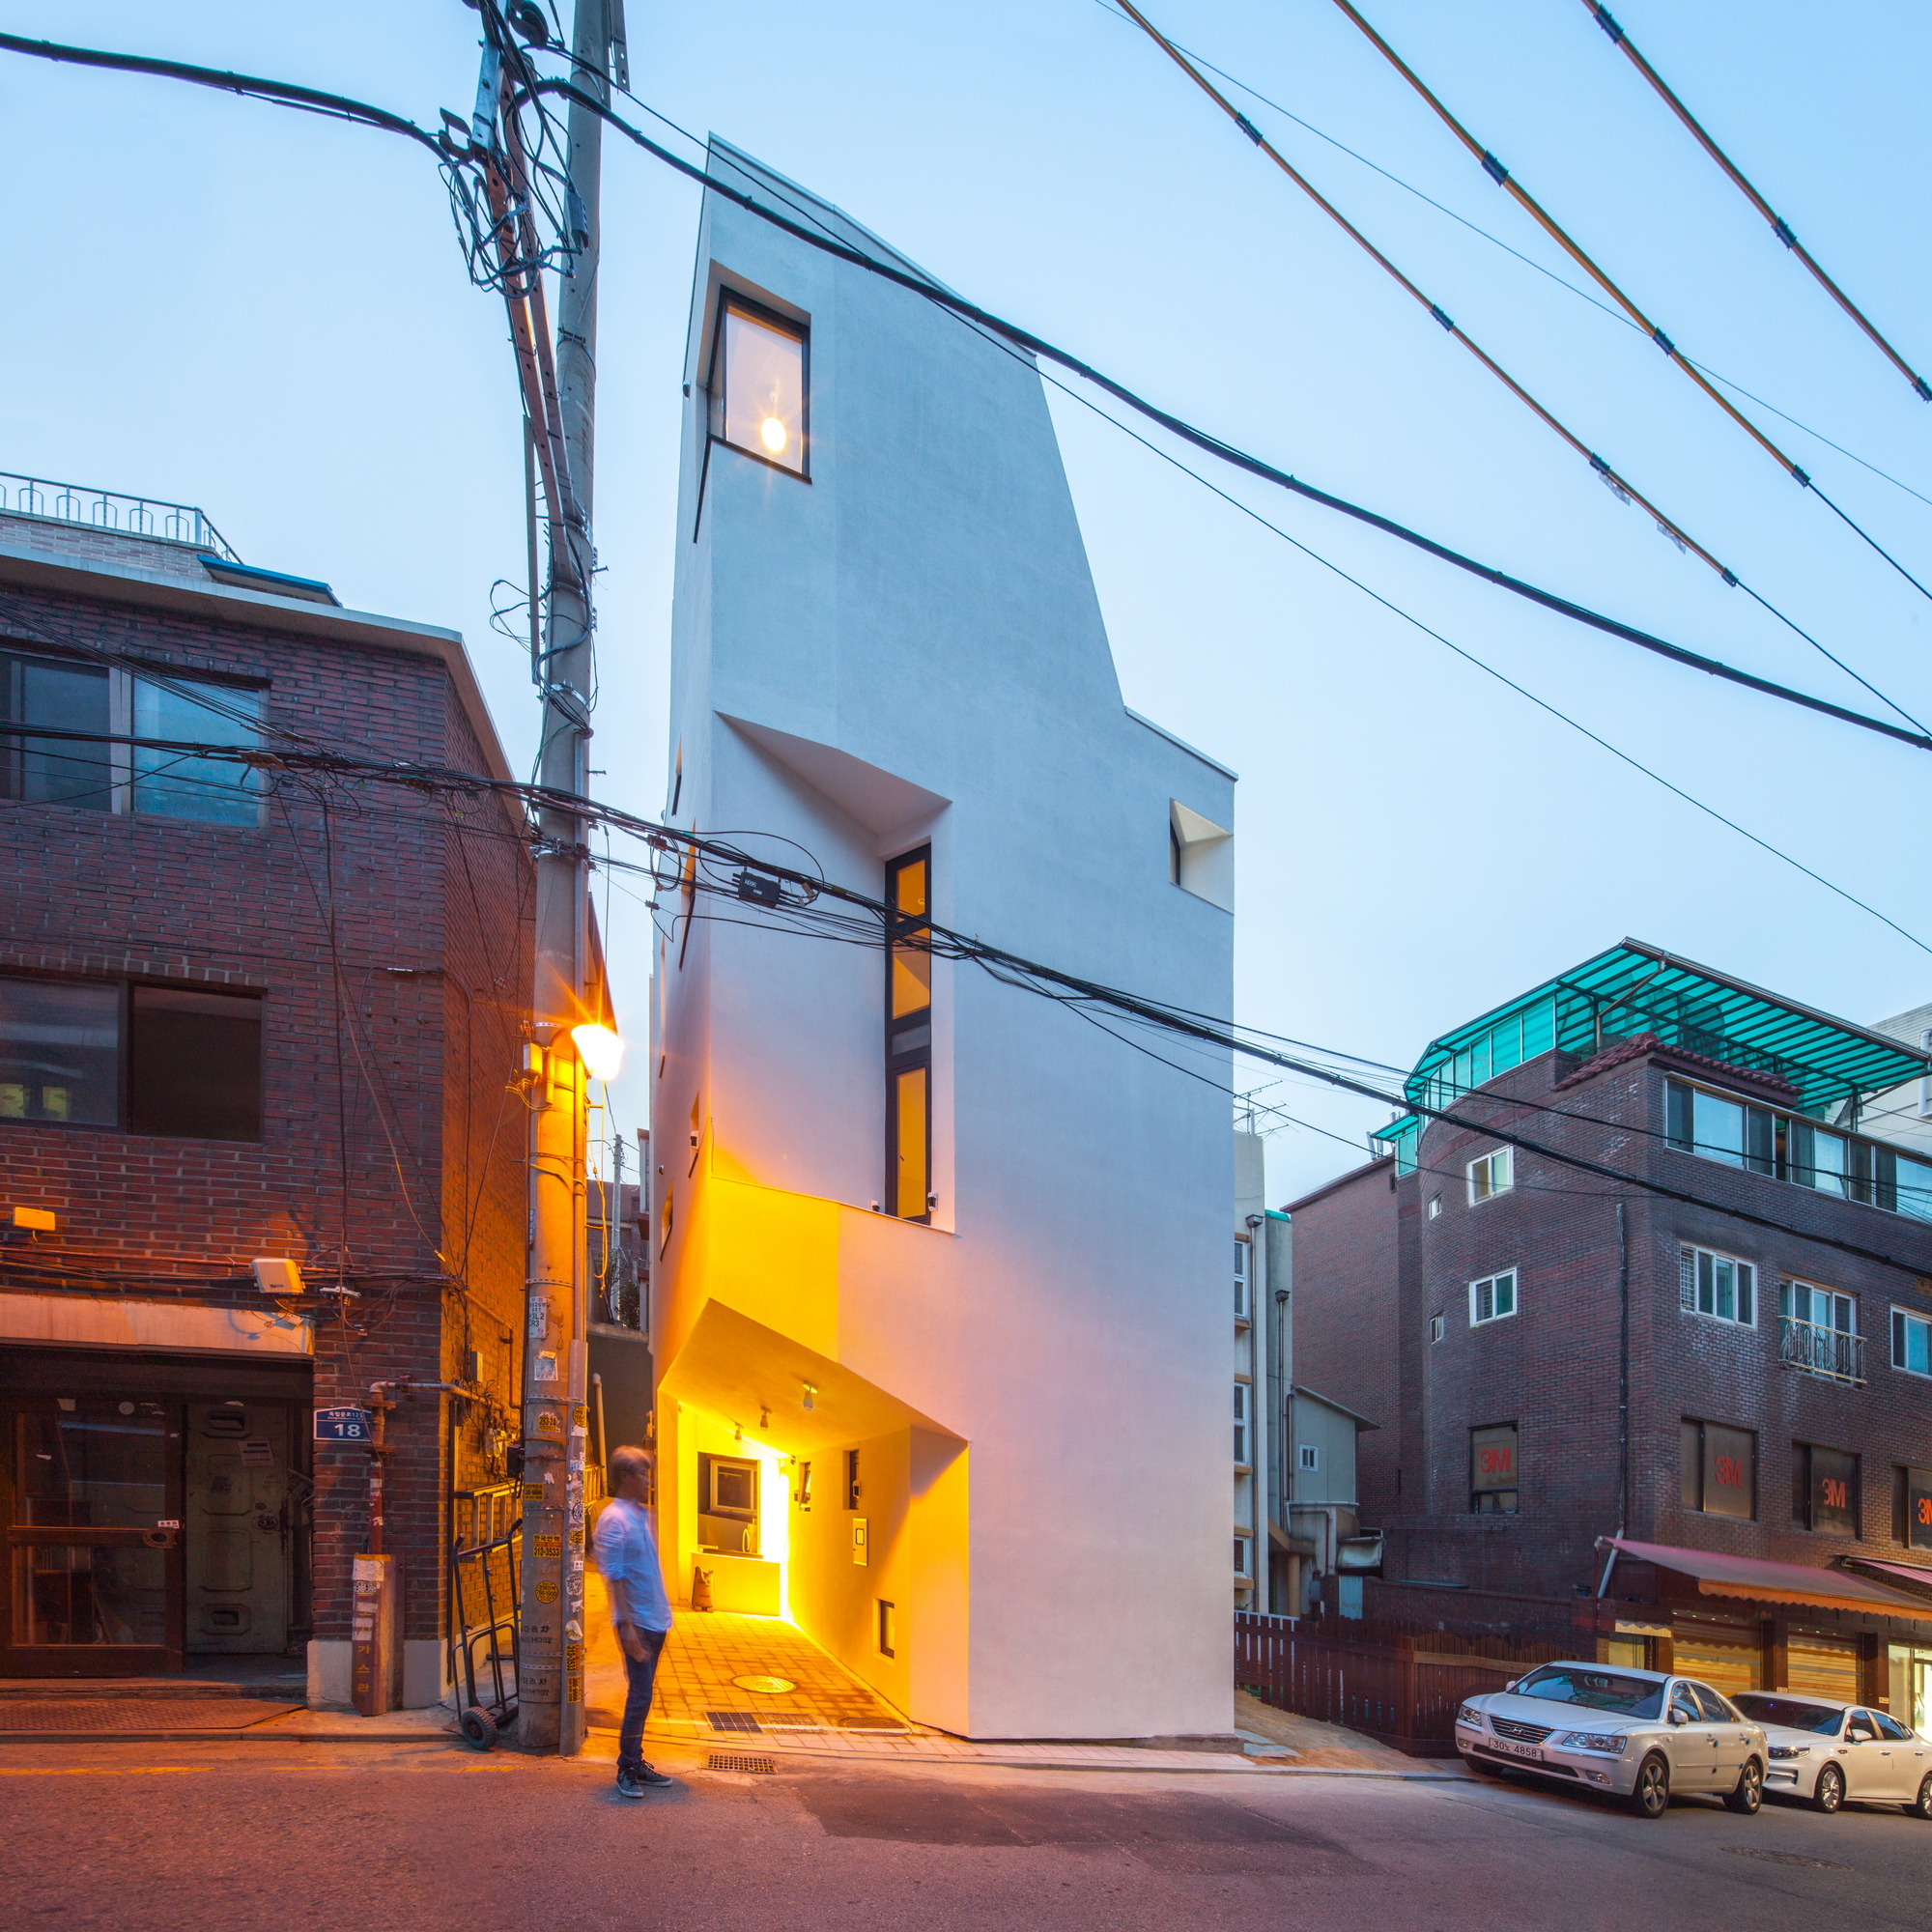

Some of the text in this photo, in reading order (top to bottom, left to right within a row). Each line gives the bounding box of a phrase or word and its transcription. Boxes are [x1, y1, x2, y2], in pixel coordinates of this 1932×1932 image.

[334, 1423, 361, 1437] 18
[1479, 1447, 1511, 1473] 3M
[1715, 1456, 1743, 1488] 3M
[1821, 1478, 1846, 1508] 3M
[533, 1547, 560, 1556] 313-3533
[1514, 1746, 1537, 1757] 4858
